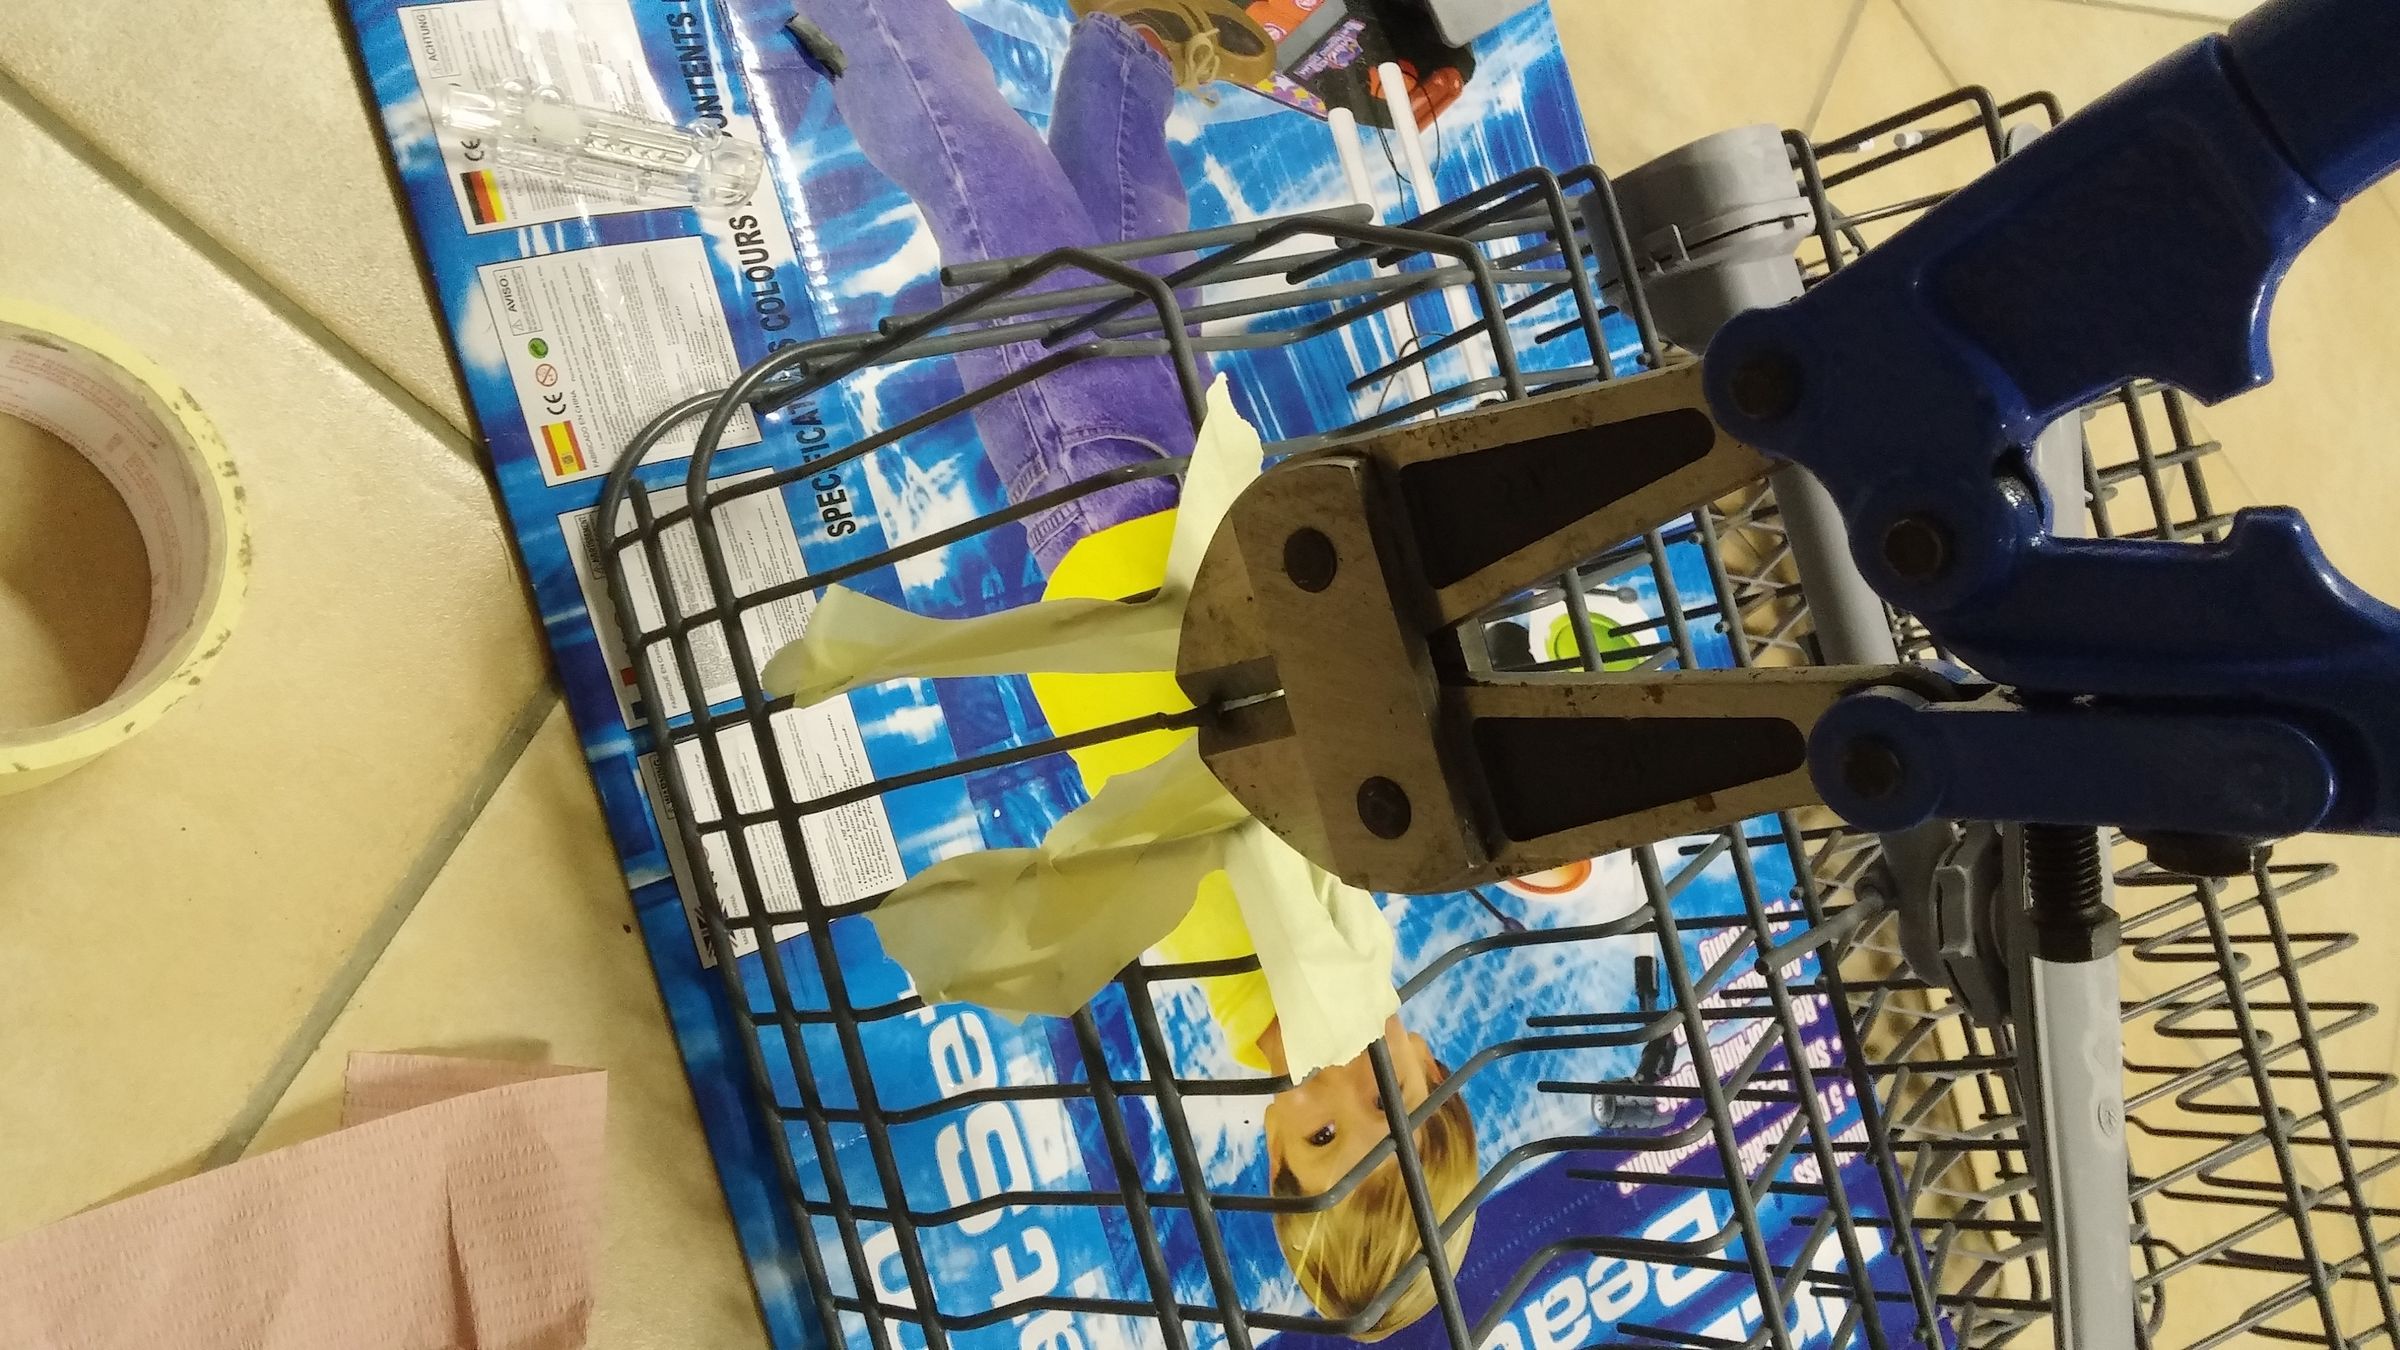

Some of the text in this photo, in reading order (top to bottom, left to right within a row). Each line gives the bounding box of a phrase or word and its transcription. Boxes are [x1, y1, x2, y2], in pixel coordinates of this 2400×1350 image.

[415, 13, 439, 63] ACHTUNG
[497, 273, 517, 313] AVISO:
[728, 210, 791, 334] COLOURS
[570, 389, 600, 468] FABRICADO EN CHINA
[766, 335, 857, 540] SPECFICATS
[659, 663, 666, 673] EN
[838, 804, 850, 832] Volum
[729, 894, 749, 944] MAD CHINA
